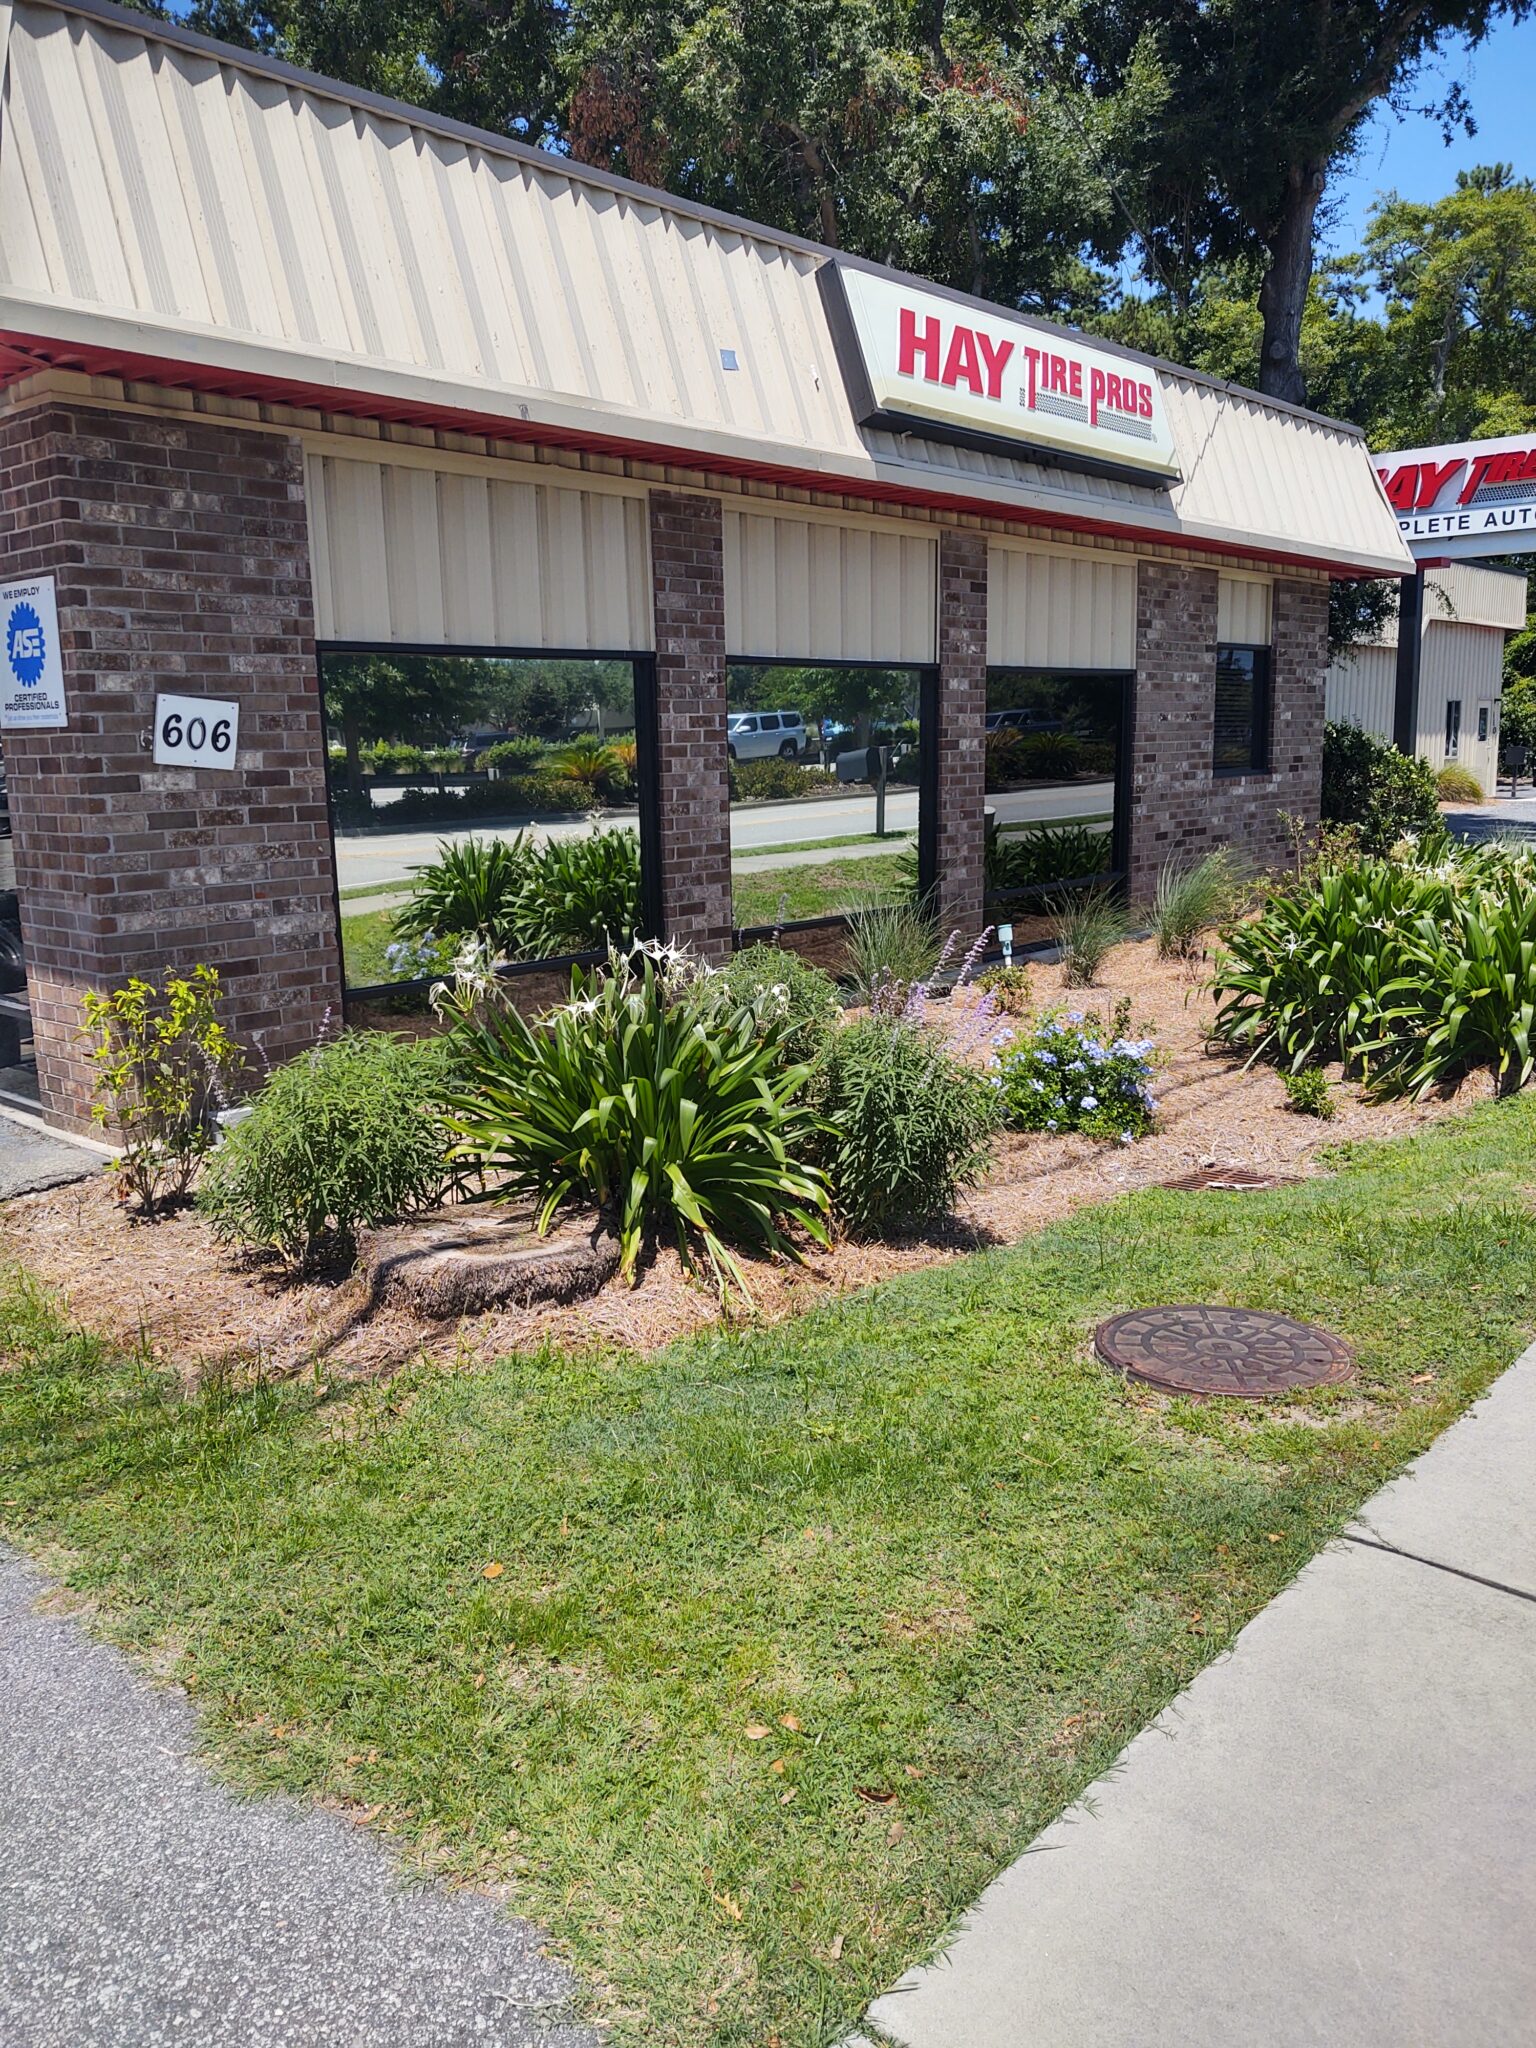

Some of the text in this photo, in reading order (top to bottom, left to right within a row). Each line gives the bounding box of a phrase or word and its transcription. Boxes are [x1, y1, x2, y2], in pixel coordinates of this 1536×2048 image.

[898, 308, 1153, 427] HAY TIRE PROS
[1376, 457, 1468, 510] AY
[1400, 508, 1536, 534] PLETE AUT
[2, 586, 40, 600] WE EMPLOY
[12, 627, 42, 659] ASE
[4, 700, 60, 711] PROFESSIONALS
[14, 692, 48, 702] CERTIFIED
[162, 714, 231, 753] 606
